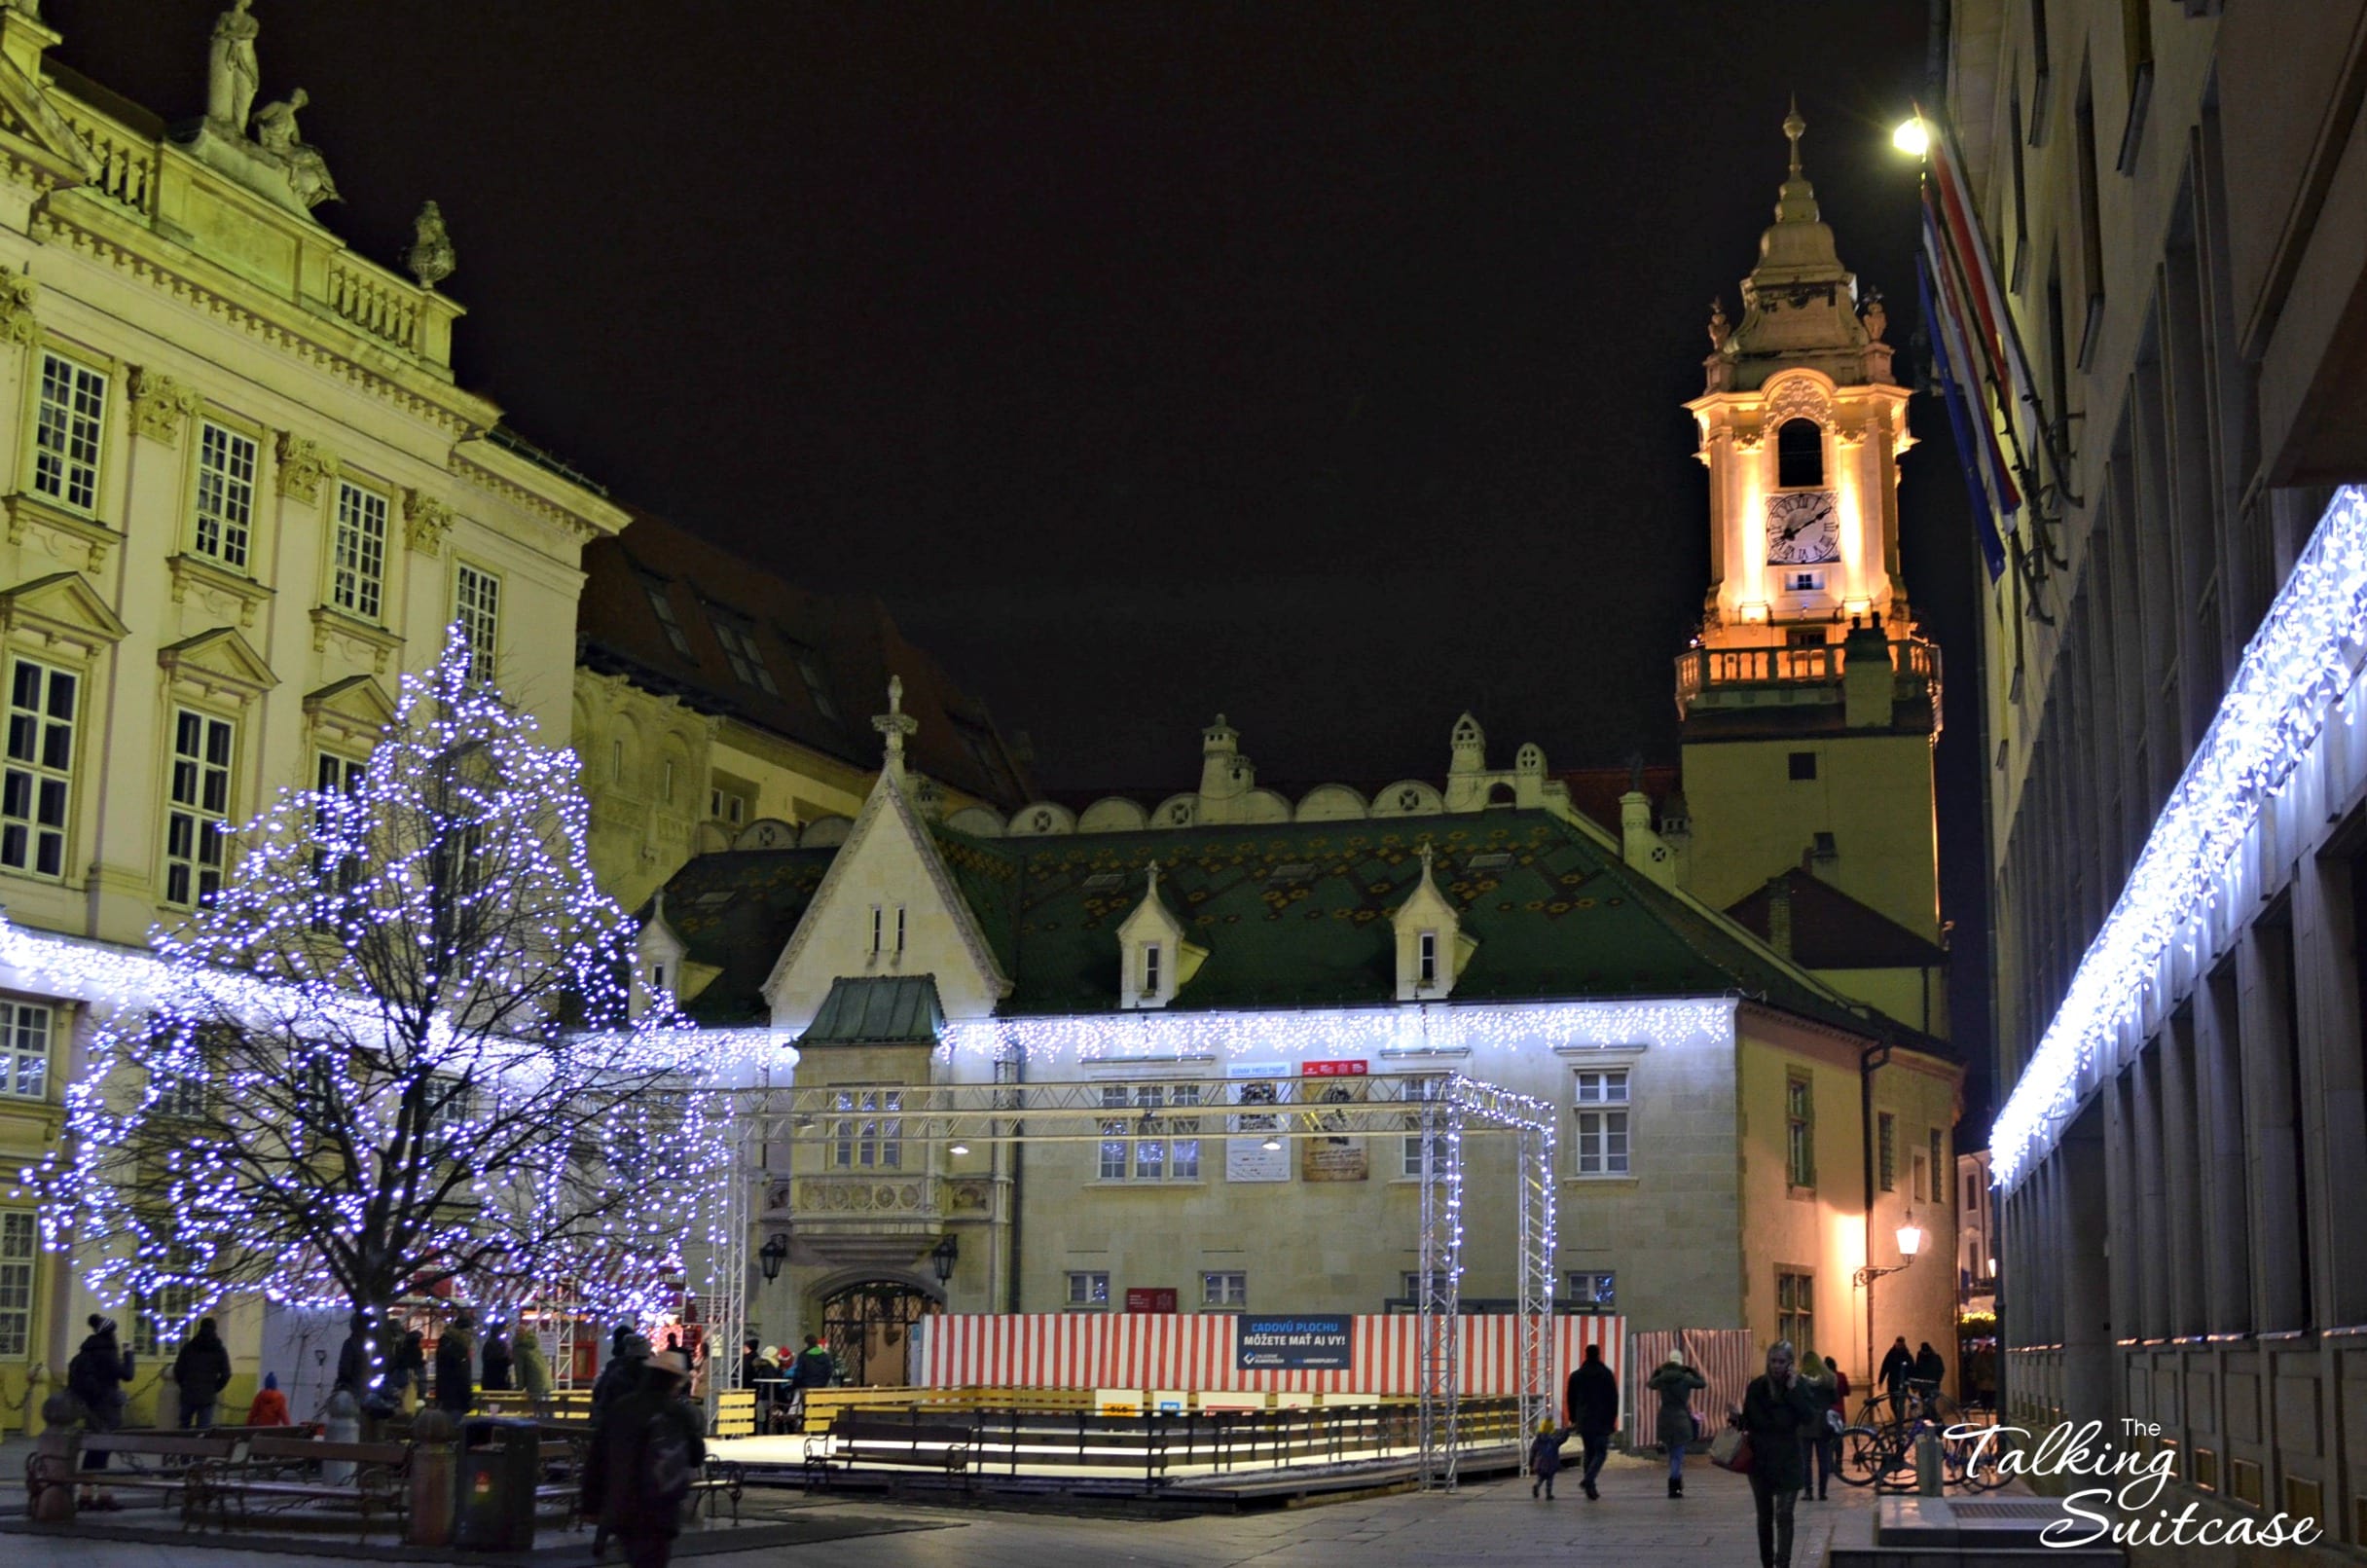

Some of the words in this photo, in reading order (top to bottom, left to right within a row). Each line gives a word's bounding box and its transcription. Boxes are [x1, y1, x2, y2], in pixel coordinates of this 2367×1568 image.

[1295, 1322, 1338, 1332] PLOCHU
[1244, 1333, 1286, 1346] MÔŽETE
[1289, 1333, 1311, 1346] MAŤ
[1314, 1335, 1326, 1347] AJ
[1328, 1335, 1346, 1346] VY!
